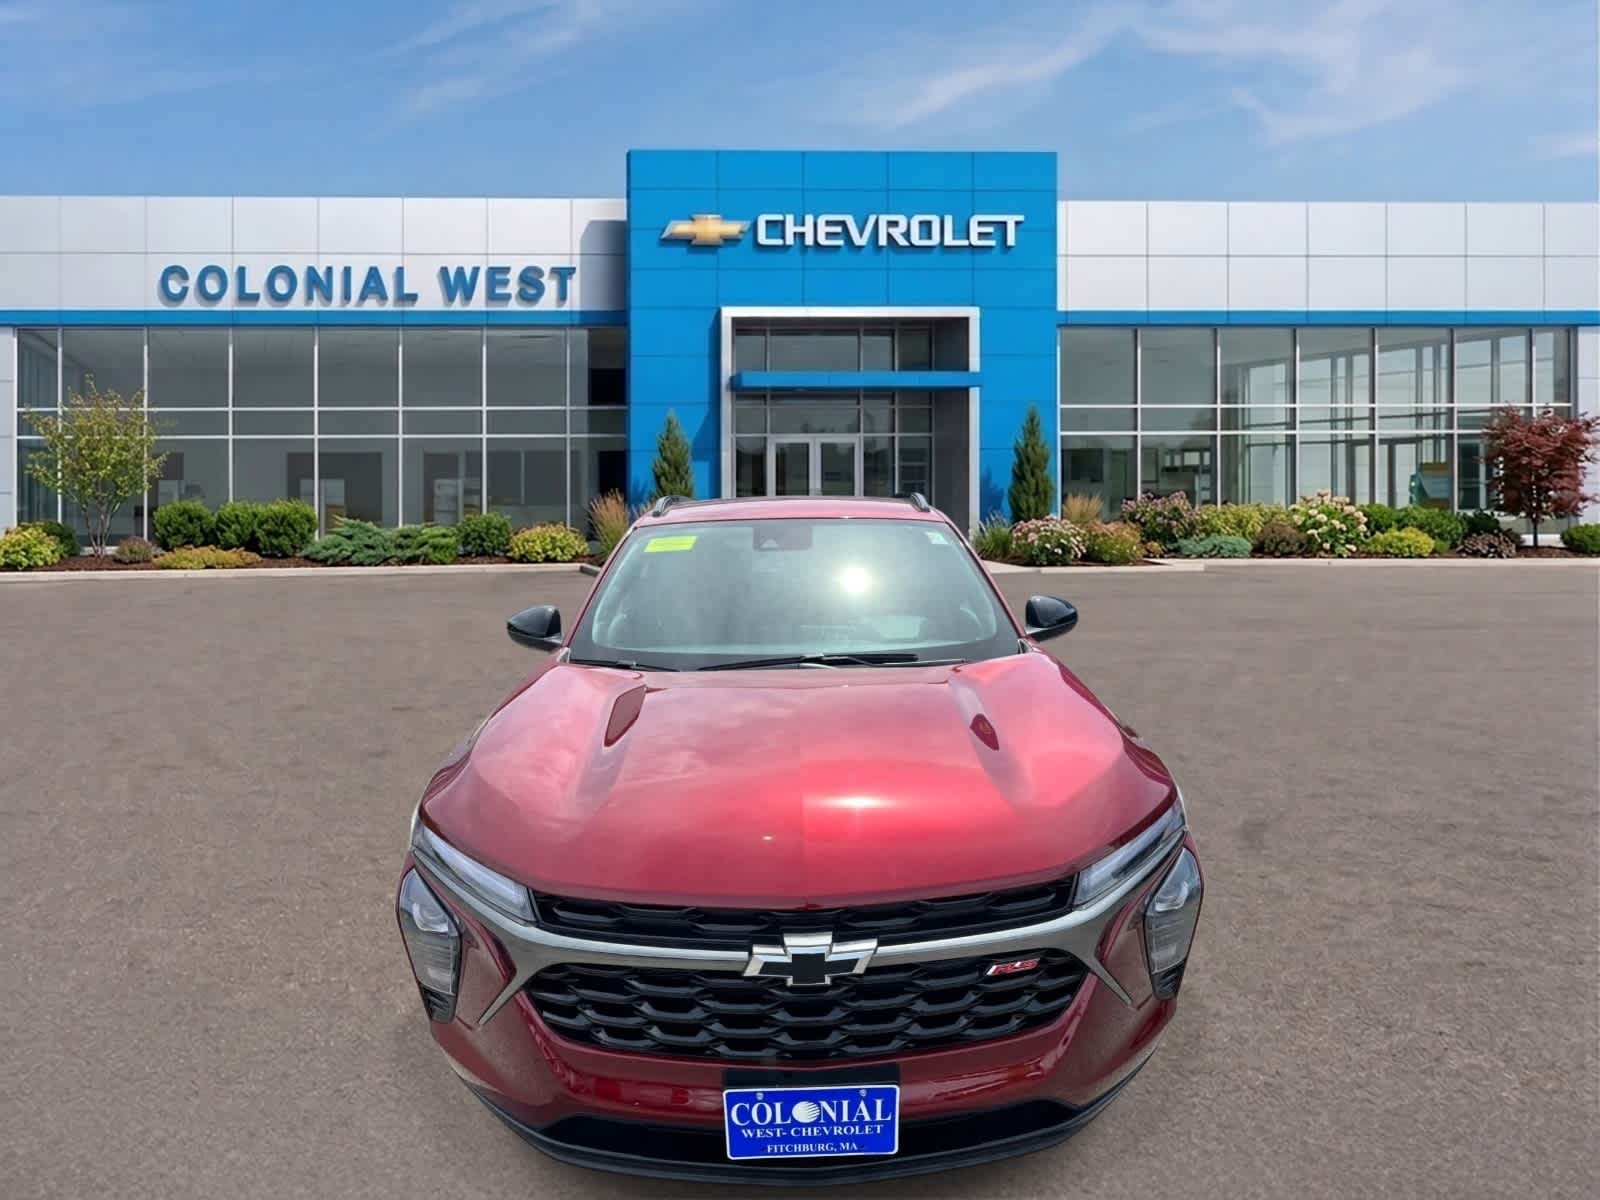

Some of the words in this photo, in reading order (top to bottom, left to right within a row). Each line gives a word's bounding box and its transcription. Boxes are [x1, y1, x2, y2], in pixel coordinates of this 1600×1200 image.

[756, 213, 1025, 247] CHEVROLET
[159, 264, 418, 304] COLONIAL
[439, 264, 577, 304] WEST
[731, 1098, 892, 1125] COLONIAL
[790, 1124, 884, 1137] CHEVROLET
[766, 1143, 837, 1153] FITCHBURG,
[839, 1142, 858, 1151] MA
